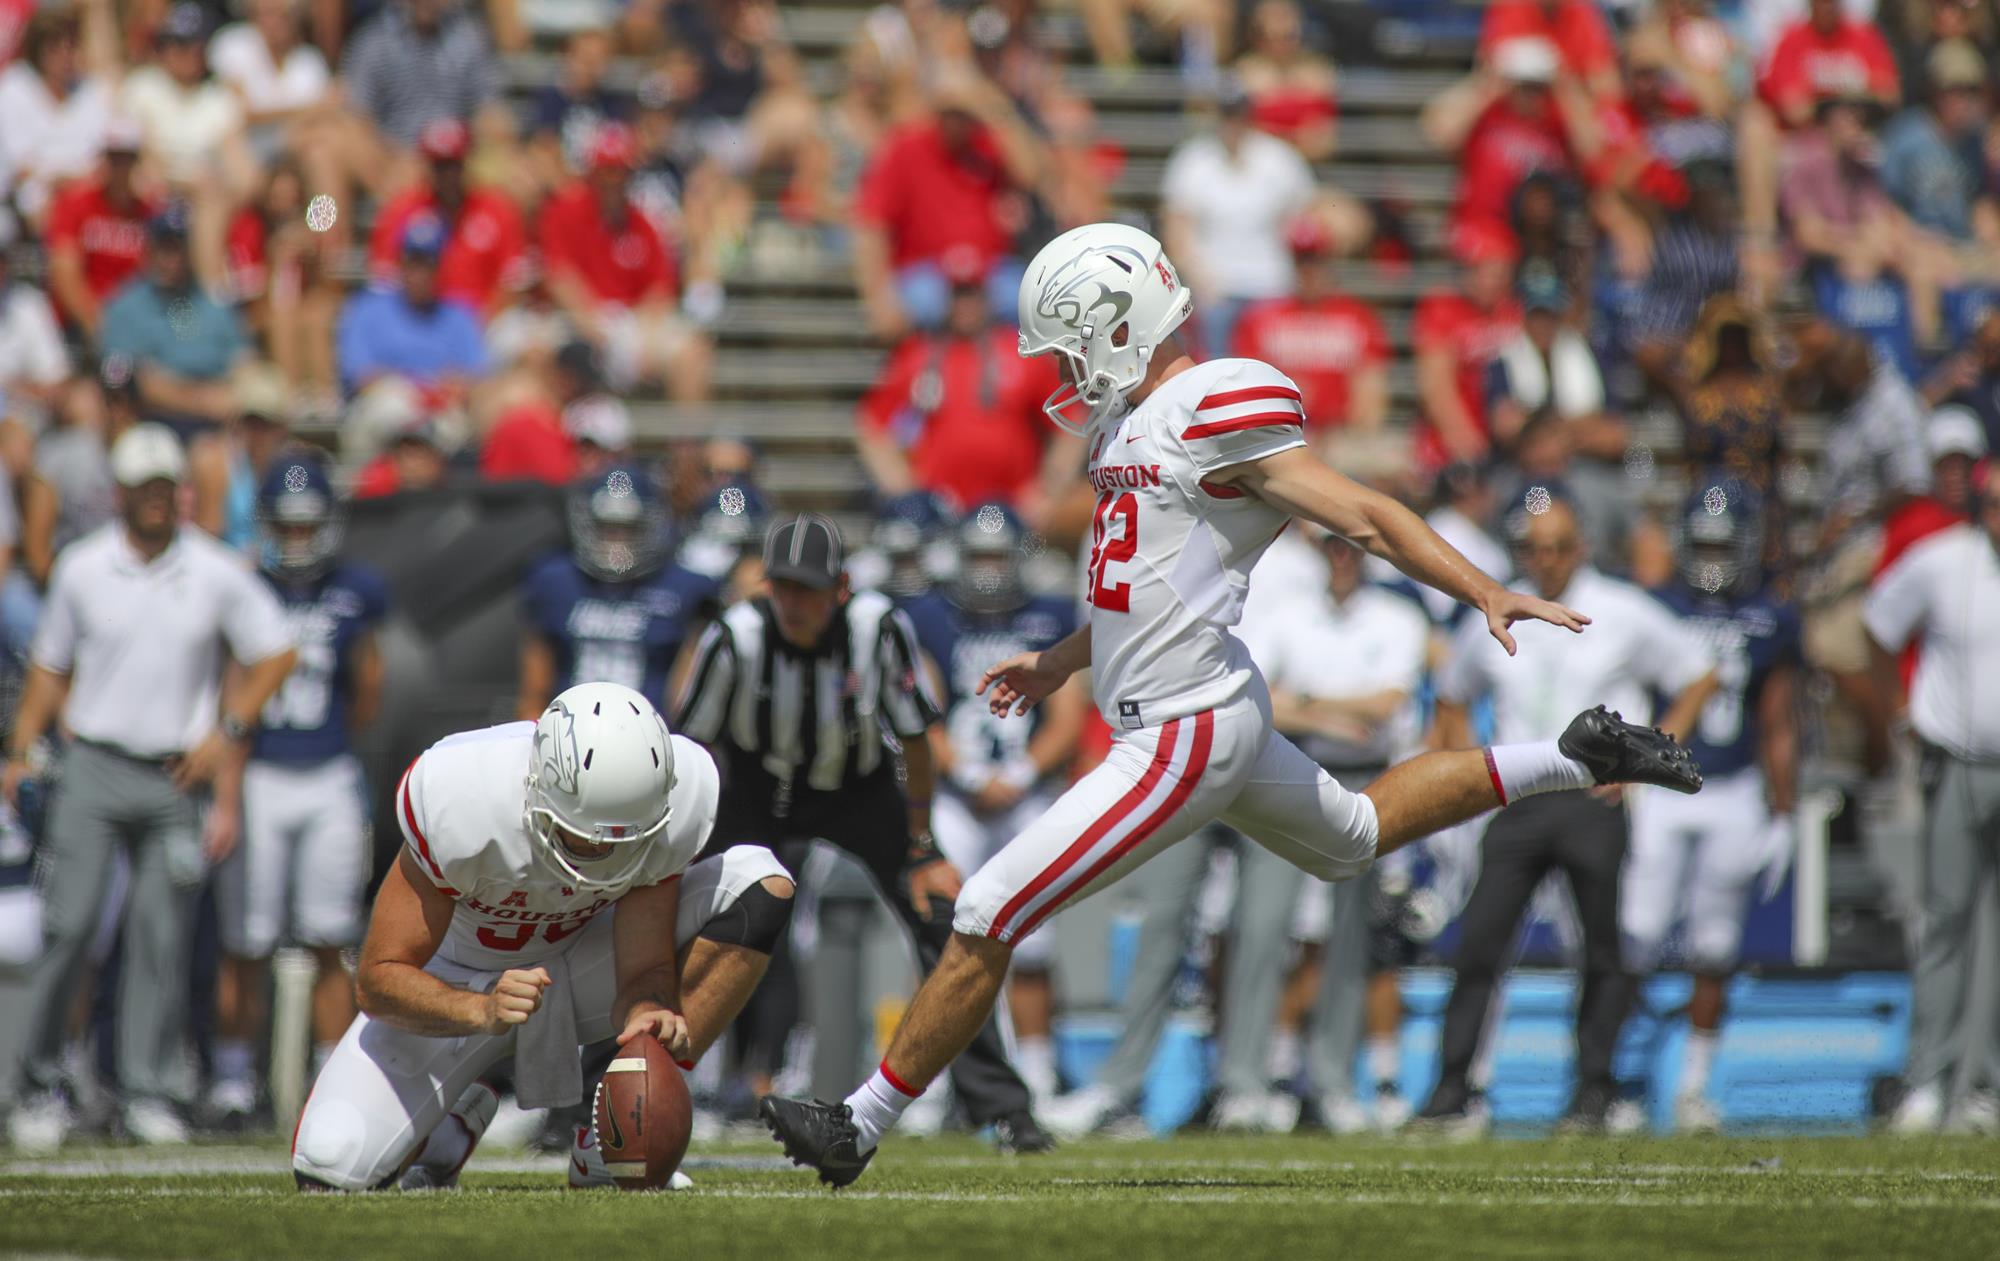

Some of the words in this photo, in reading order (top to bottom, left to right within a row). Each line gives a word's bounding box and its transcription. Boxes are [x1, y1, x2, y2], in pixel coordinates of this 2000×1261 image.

[1088, 465, 1160, 492] OUSTON
[1124, 704, 1133, 715] M
[468, 897, 611, 921] HOUSTO
